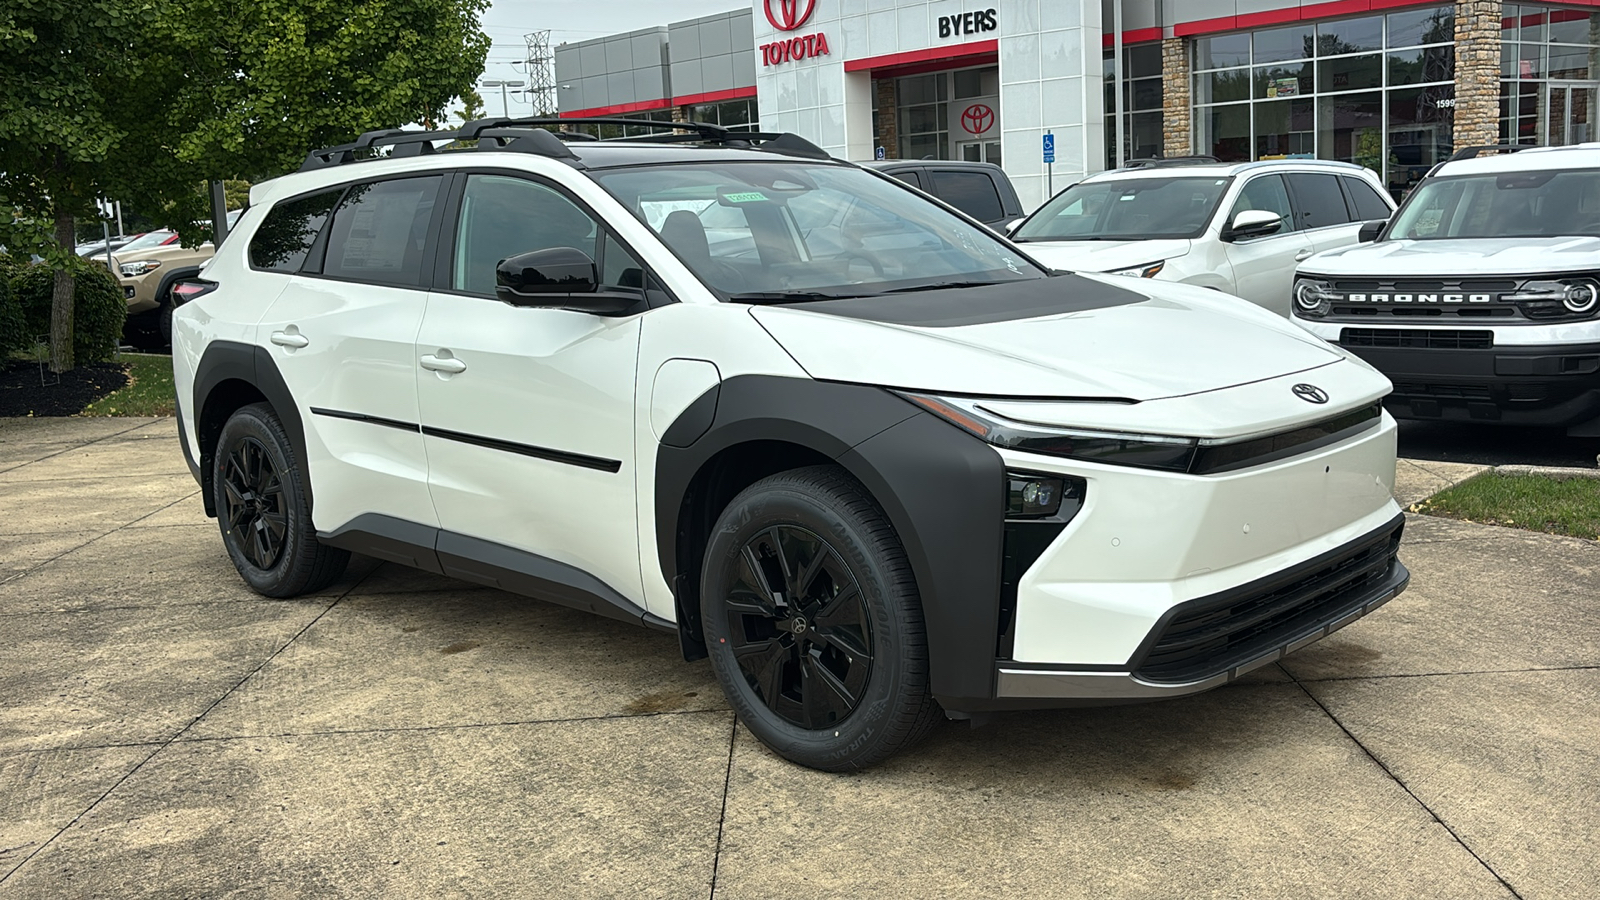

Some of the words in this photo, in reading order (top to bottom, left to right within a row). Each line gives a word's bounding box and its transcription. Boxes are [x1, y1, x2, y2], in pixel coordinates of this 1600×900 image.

[938, 8, 997, 39] BYERS
[760, 32, 829, 67] TOYOTA
[1436, 99, 1455, 109] 1599
[1348, 293, 1491, 304] BRONCO
[832, 521, 892, 650] BRIDGESTONE
